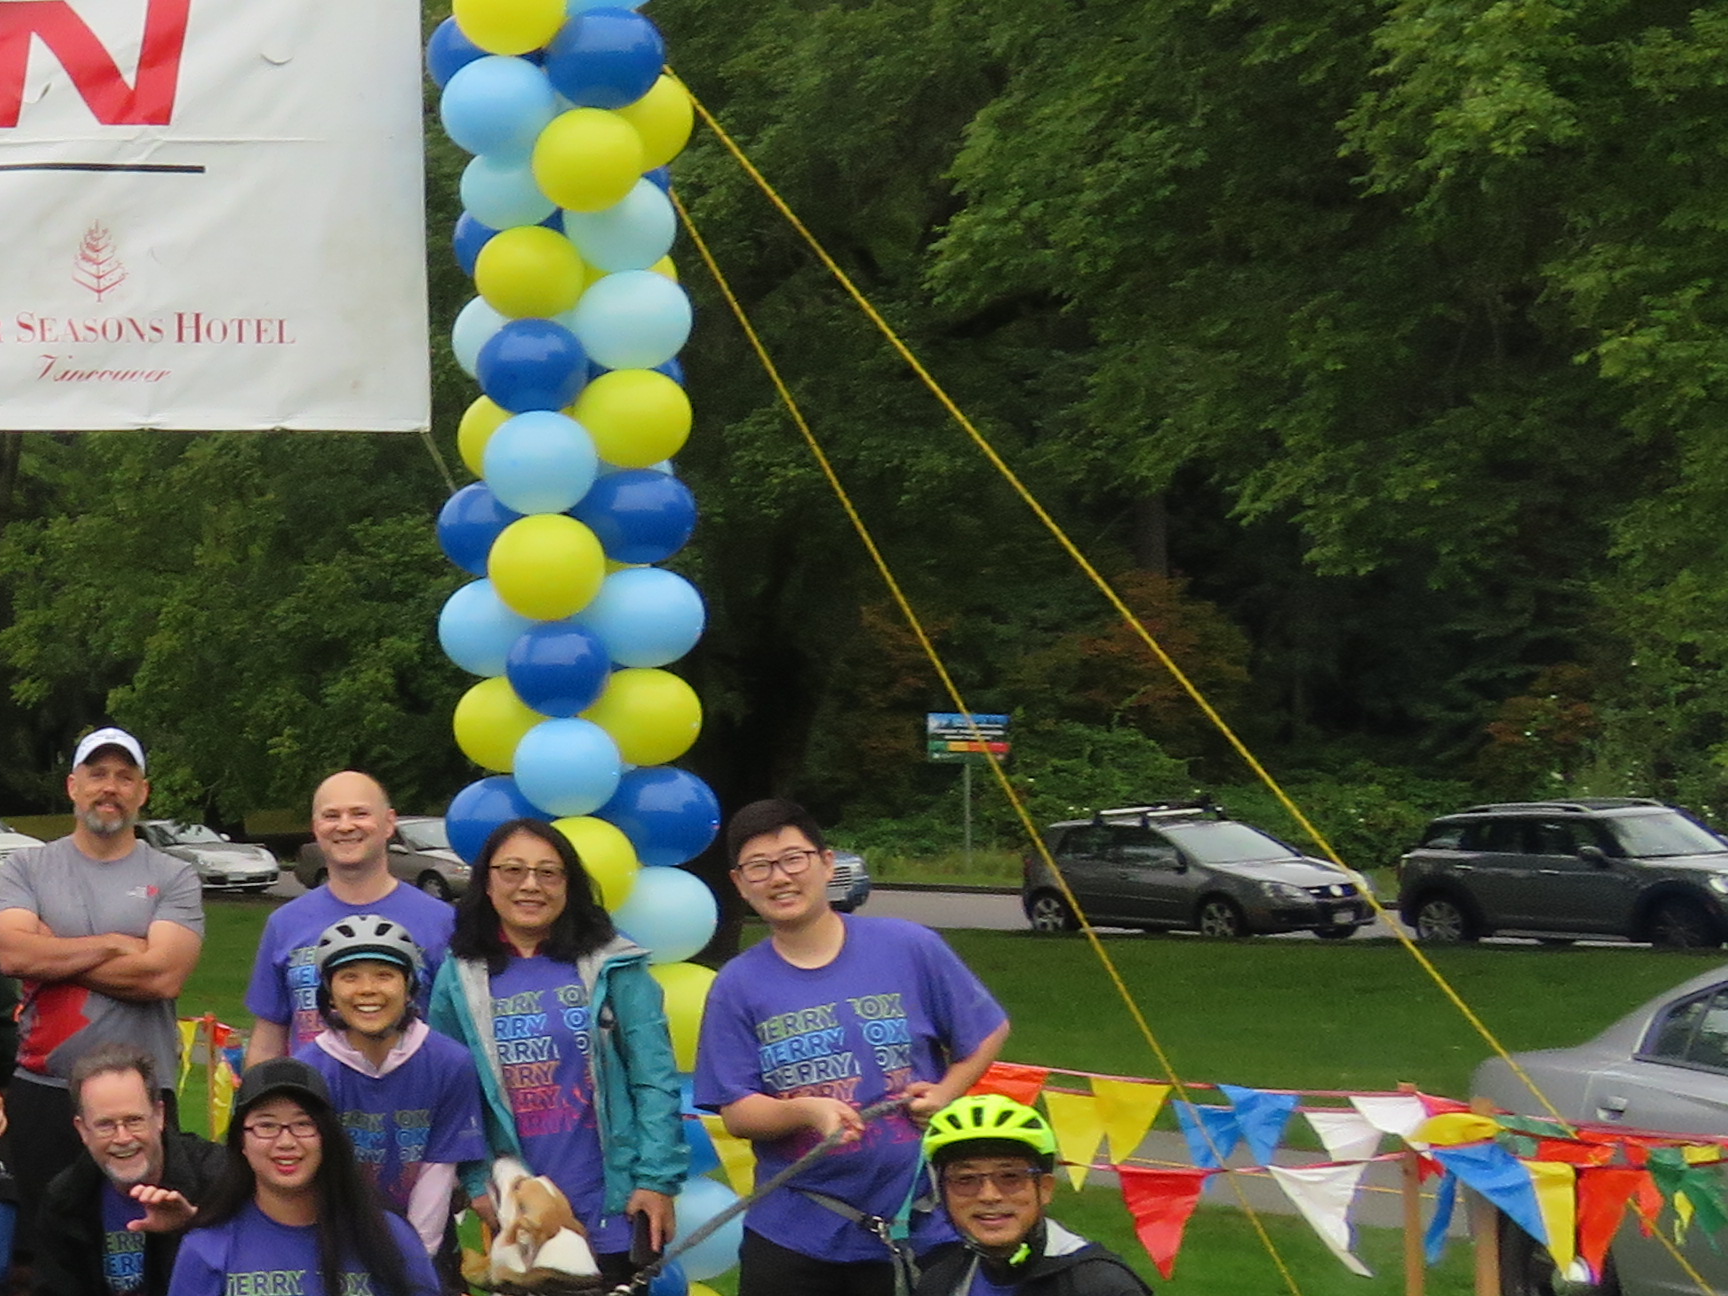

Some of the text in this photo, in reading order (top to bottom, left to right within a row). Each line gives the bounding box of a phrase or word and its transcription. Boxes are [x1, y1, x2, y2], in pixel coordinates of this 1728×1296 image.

[845, 992, 907, 1020] OX
[493, 1012, 548, 1040] RRY
[858, 1018, 913, 1046] OX
[495, 1035, 553, 1064] RRY
